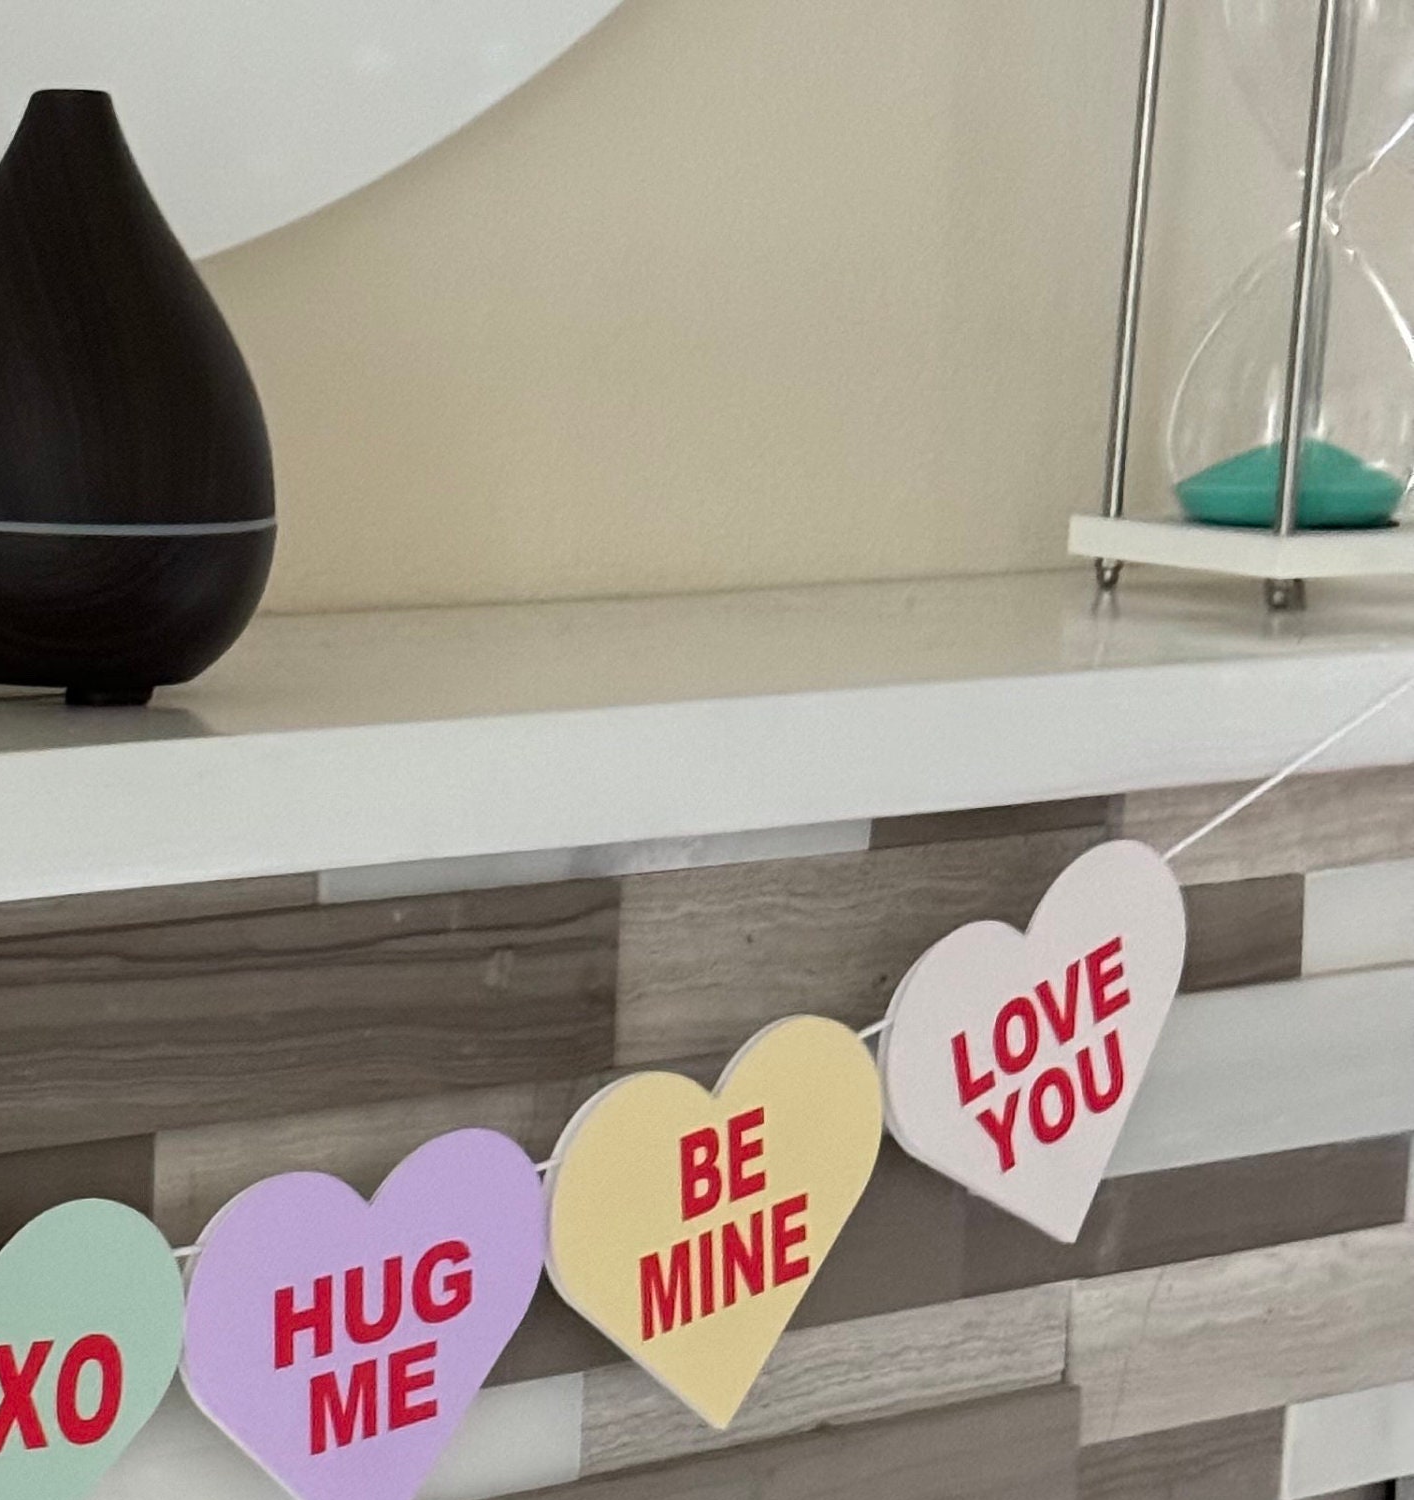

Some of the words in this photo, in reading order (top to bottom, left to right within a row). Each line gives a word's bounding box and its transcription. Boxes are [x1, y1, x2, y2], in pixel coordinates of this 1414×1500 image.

[952, 937, 1132, 1106] LOVE
[678, 1107, 767, 1221] BE
[976, 1029, 1127, 1173] YOU
[272, 1238, 474, 1371] HUG
[638, 1194, 811, 1341] MINE
[308, 1339, 439, 1456] ME
